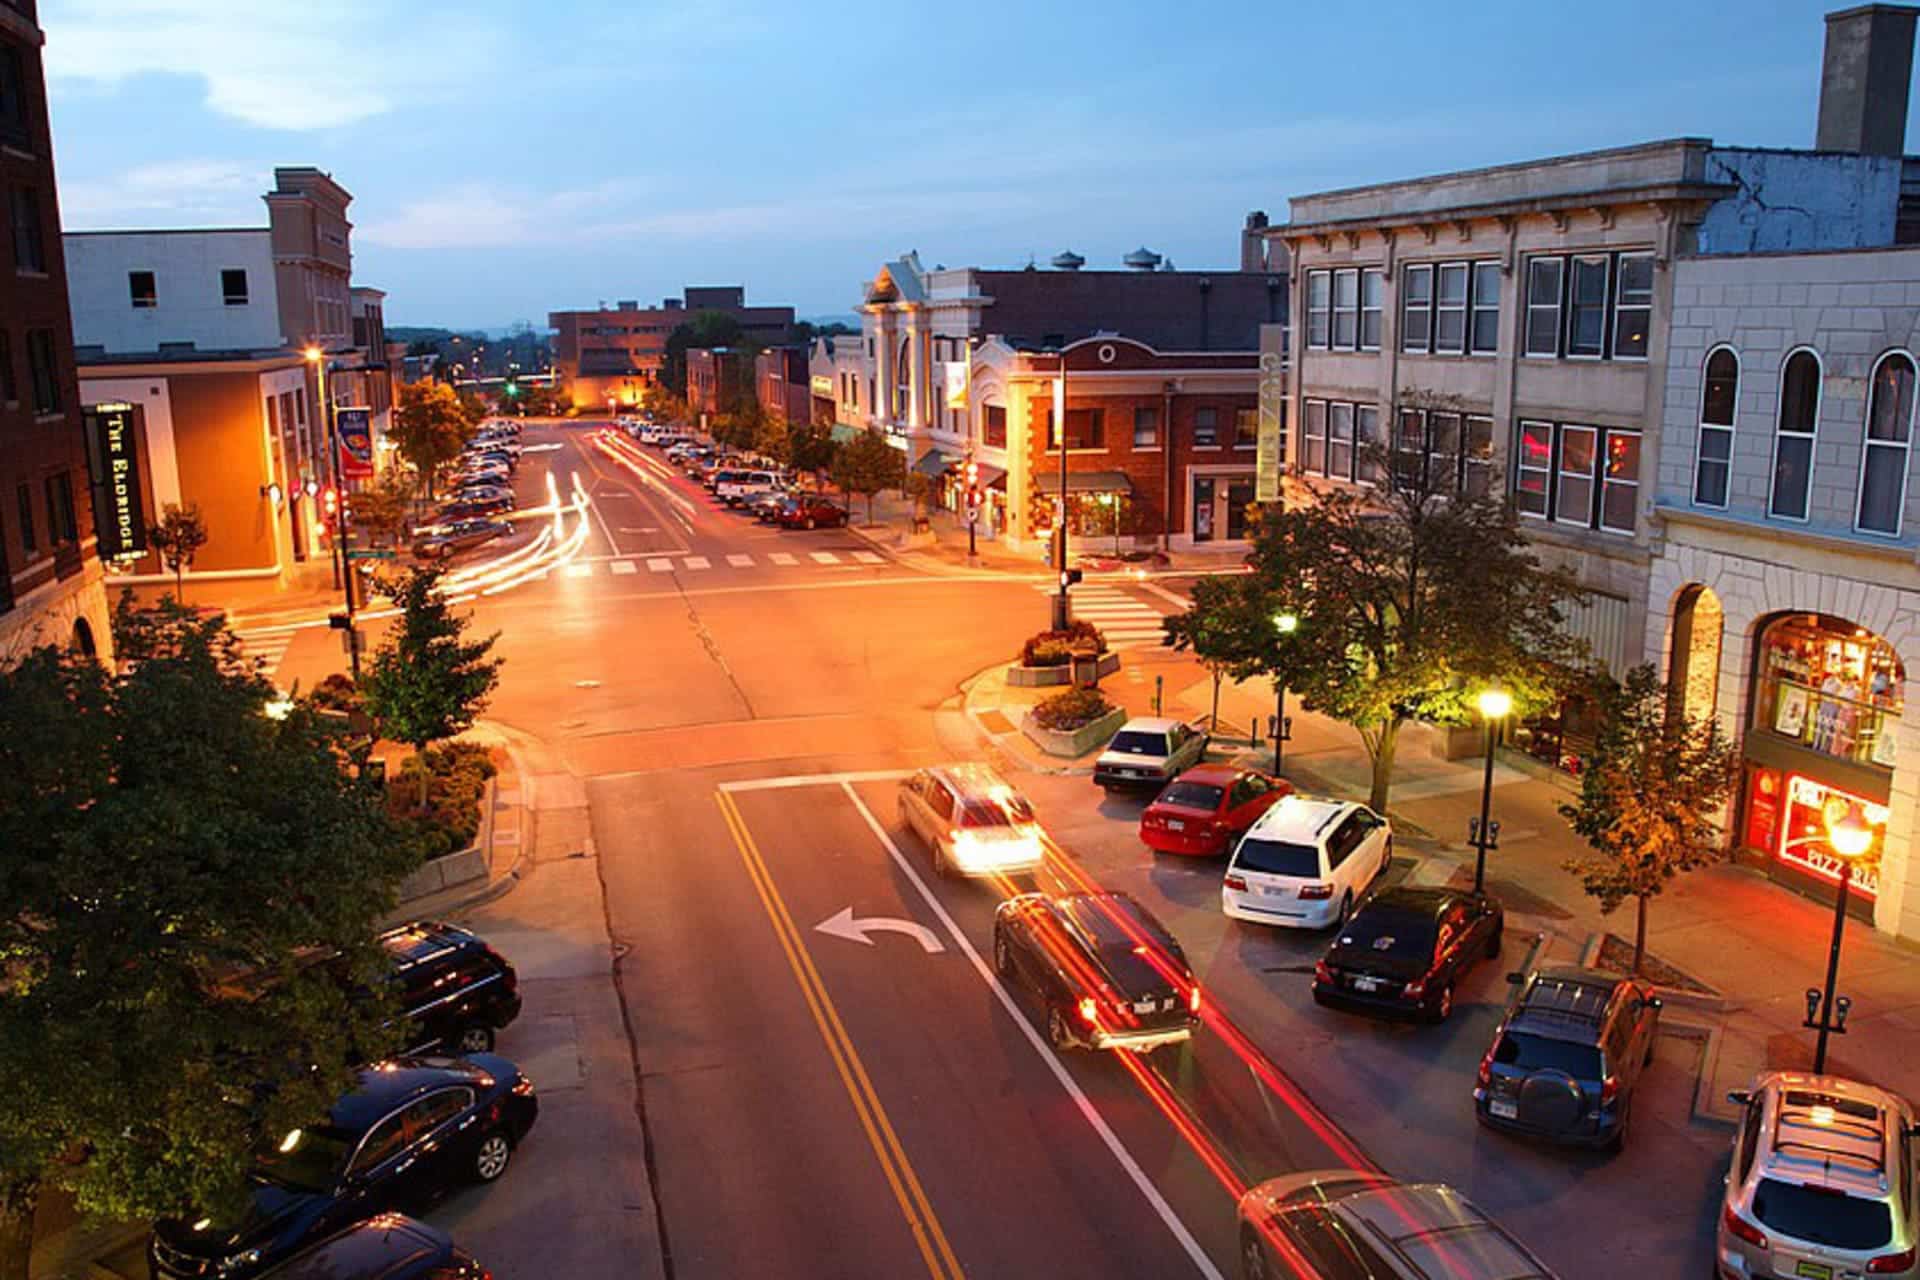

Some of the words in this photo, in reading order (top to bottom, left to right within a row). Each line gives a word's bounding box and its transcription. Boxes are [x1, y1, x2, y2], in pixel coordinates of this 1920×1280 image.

[107, 413, 124, 452] THE
[112, 459, 133, 549] ELDRIDGE
[1806, 848, 1880, 890] PIZZRIA
